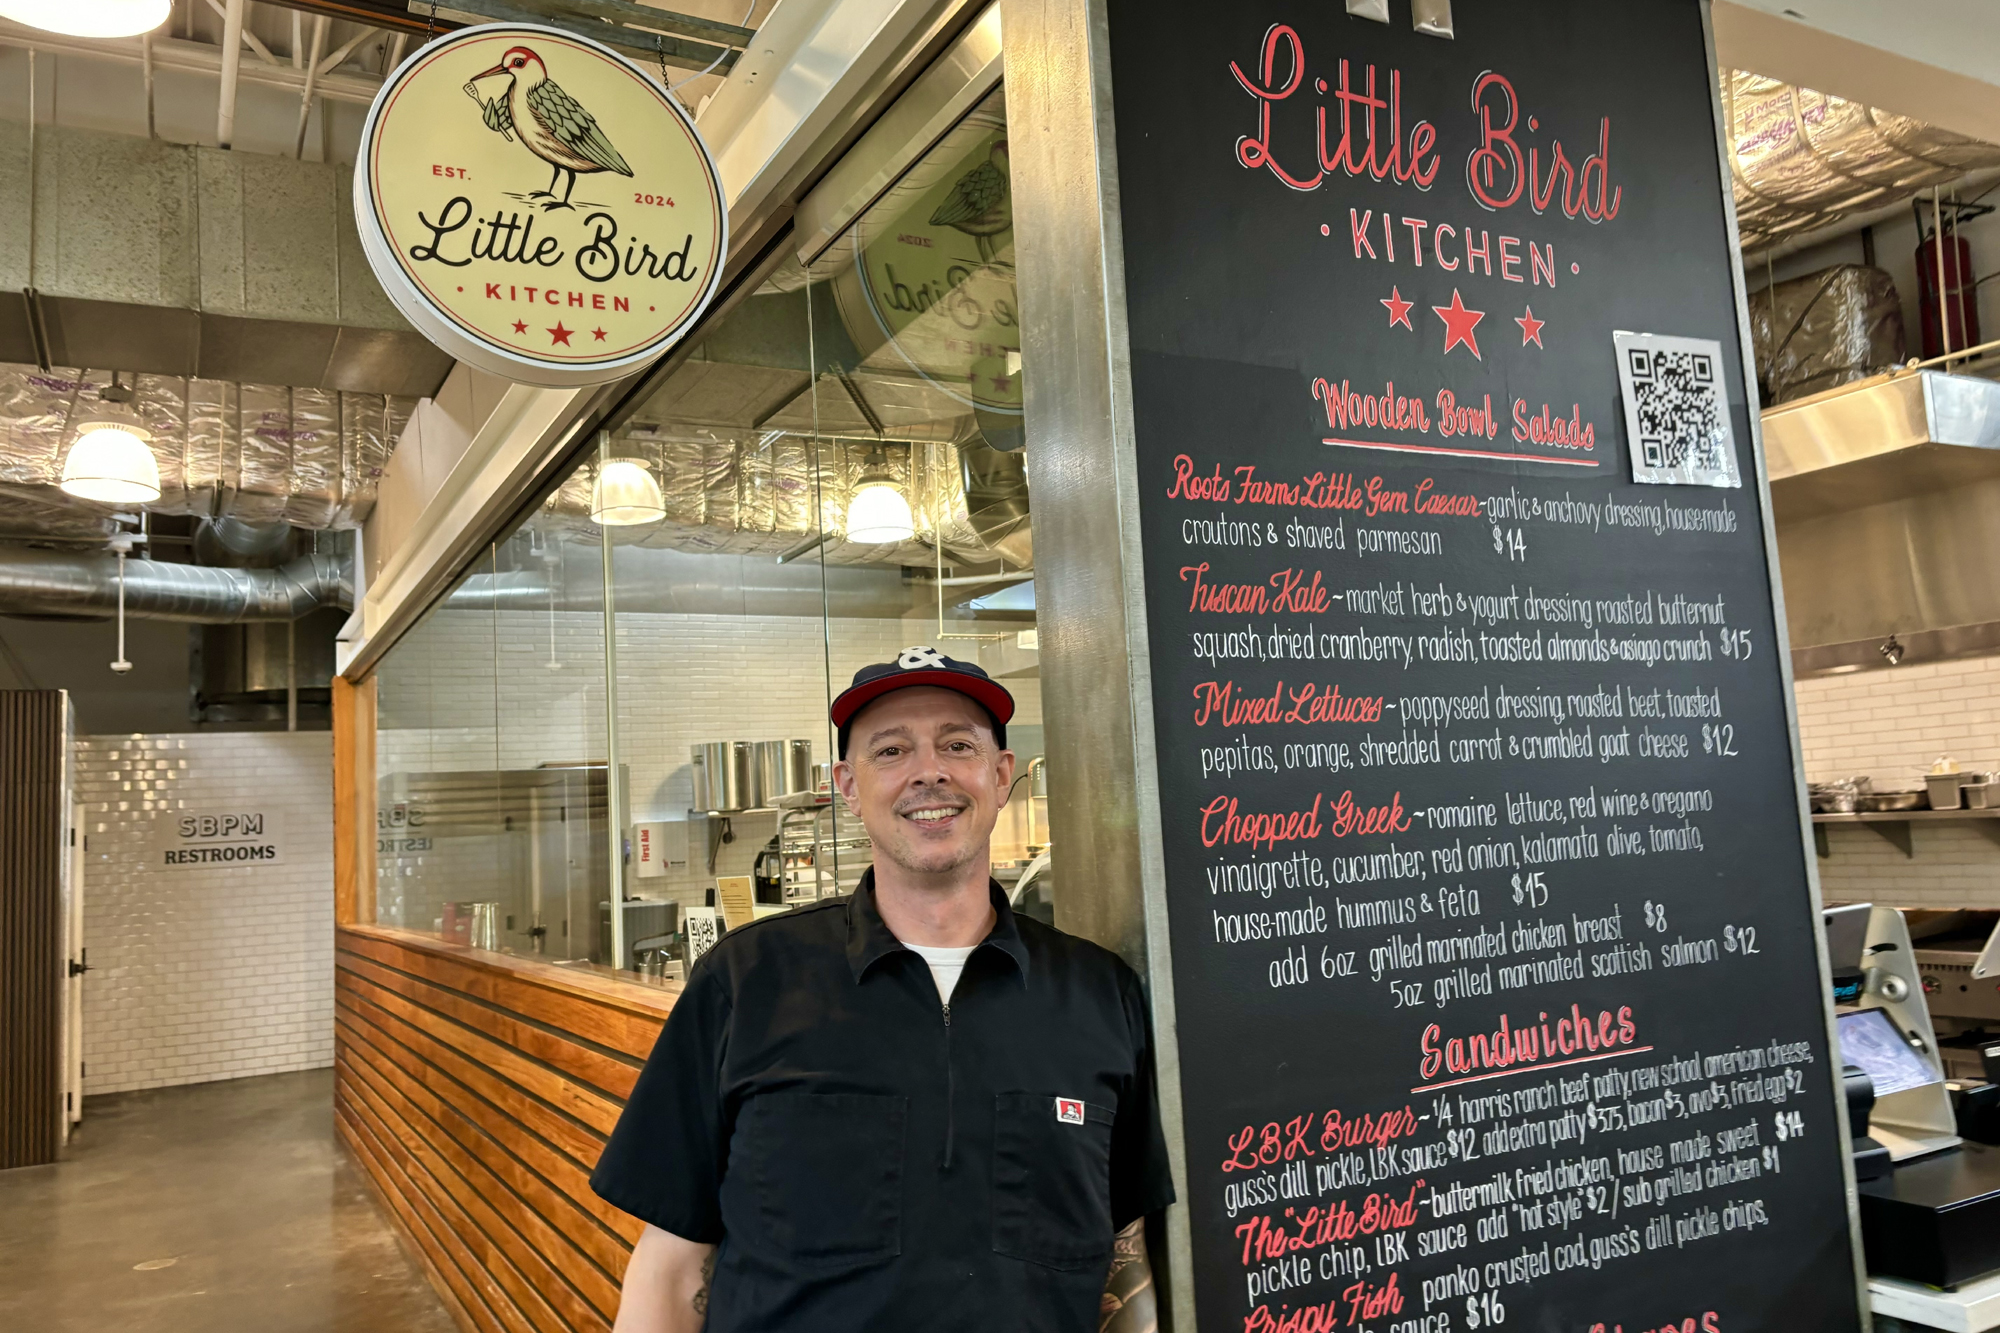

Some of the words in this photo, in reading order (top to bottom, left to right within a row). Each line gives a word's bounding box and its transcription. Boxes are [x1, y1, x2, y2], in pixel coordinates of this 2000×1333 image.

[1229, 22, 1440, 191] Little
[1466, 70, 1621, 224] Bird
[432, 164, 472, 181] EST.
[634, 193, 675, 208] 2024
[410, 196, 564, 267] Little
[575, 212, 697, 283] Bird
[1350, 208, 1555, 288] KITCHEN
[485, 283, 630, 312] KITCHEN
[1311, 377, 1430, 431] Wooden
[1436, 389, 1498, 440] Bowl
[1512, 394, 1595, 451] Salads
[1167, 454, 1230, 501] Roots
[1234, 466, 1300, 505] Farms
[1300, 472, 1363, 509] Little
[1365, 476, 1410, 517] Gem
[1414, 478, 1482, 517] Caesar
[1532, 497, 1542, 516] &
[1544, 492, 1601, 533] anchovy
[1182, 512, 1262, 547] croutons
[1267, 523, 1278, 544] &
[1286, 516, 1345, 550] shaved
[1357, 527, 1442, 558] parmesan
[1493, 525, 1527, 562] $14
[1179, 562, 1270, 613] Tuscan
[1270, 568, 1331, 613] Kale
[1411, 582, 1452, 617] herb
[1456, 592, 1467, 611] &
[1468, 584, 1519, 626] yogurt
[1524, 586, 1593, 629] dressing
[1595, 590, 1653, 625] roasted
[1658, 594, 1726, 626] butternut
[1418, 625, 1479, 665] radish,
[1479, 629, 1543, 662] toasted
[1547, 628, 1610, 662] almonds
[1663, 629, 1713, 662] crunch
[1720, 626, 1754, 661] $15
[1193, 681, 1284, 727] Mixed
[1285, 683, 1384, 724] Lettuces
[1567, 684, 1623, 718] roasted
[1627, 685, 1665, 720] beet,
[1667, 686, 1722, 718] toasted
[1201, 733, 1279, 779] pepitas,
[1284, 742, 1354, 773] orange,
[1360, 729, 1440, 766] shredded
[1449, 727, 1502, 763] carrot
[1508, 735, 1519, 756] &
[1522, 725, 1593, 760] crumbled
[1599, 726, 1630, 763] goat
[1638, 725, 1689, 758] cheese
[1702, 723, 1739, 757] $12
[178, 813, 264, 838] SBPM
[641, 829, 650, 842] Aid
[641, 844, 650, 862] First
[1200, 793, 1322, 852] Chopped
[1330, 790, 1412, 837] Greek
[1506, 792, 1567, 825] lettuce,
[1569, 786, 1597, 819] red
[1600, 789, 1639, 817] wine
[1640, 792, 1649, 810] &
[1652, 789, 1713, 818] oregano
[164, 845, 276, 865] RESTROOMS
[1207, 850, 1330, 899] vinaigrette,
[1333, 843, 1427, 881] cucumber,
[1432, 838, 1463, 873] red
[1468, 837, 1520, 870] onion,
[1520, 825, 1599, 865] kalamata
[1607, 824, 1646, 857] olive,
[1648, 818, 1704, 852] tomato,
[1213, 896, 1328, 943] house-made
[1336, 892, 1417, 929] hummus
[1420, 893, 1433, 913] &
[1438, 883, 1481, 919] feta
[1510, 872, 1549, 908] $15
[1269, 945, 1309, 988] add
[1321, 945, 1358, 979] 6oz
[1370, 933, 1423, 982] grilled
[1427, 921, 1507, 964] marinated
[1511, 918, 1567, 954] chicken
[1573, 903, 1623, 945] breast
[1644, 900, 1668, 933] $8
[1390, 979, 1425, 1009] 5oz
[1434, 963, 1493, 1009] grilled
[1499, 951, 1584, 991] marinated
[1591, 941, 1652, 977] scottish
[1661, 936, 1719, 968] salmon
[1723, 924, 1760, 956] $12
[1419, 1003, 1636, 1080] Sandwiches
[1320, 1104, 1418, 1152] Burger
[1459, 1089, 1512, 1124] harris
[1513, 1080, 1558, 1114] ranch
[1560, 1073, 1590, 1105] beef
[1704, 1045, 1767, 1078] american
[1280, 1160, 1310, 1199] dill
[1401, 1140, 1448, 1174] sauce
[1447, 1128, 1480, 1162] $12
[1548, 1109, 1586, 1149] patty
[1730, 1073, 1765, 1105] fried
[1235, 1216, 1287, 1265] The
[1516, 1160, 1554, 1198] fried
[1554, 1156, 1614, 1191] chicken,
[1617, 1143, 1665, 1175] house
[1670, 1130, 1711, 1164] made
[1716, 1118, 1760, 1155] sweet
[1775, 1111, 1805, 1141] $14
[1247, 1255, 1311, 1307] pickle
[1319, 1242, 1371, 1279] chip,
[1417, 1223, 1468, 1256] sauce
[1477, 1206, 1508, 1243] add
[1622, 1176, 1652, 1207] sub
[1654, 1163, 1703, 1206] grilled
[1705, 1155, 1761, 1188] chicken
[1343, 1272, 1405, 1327] Fish
[1422, 1264, 1480, 1312] panko
[1485, 1246, 1551, 1288] crusted
[1554, 1232, 1589, 1271] cod,
[1645, 1213, 1674, 1250] dill
[1675, 1205, 1720, 1249] pickle
[1722, 1200, 1769, 1231] chips,
[1466, 1289, 1505, 1330] $16
